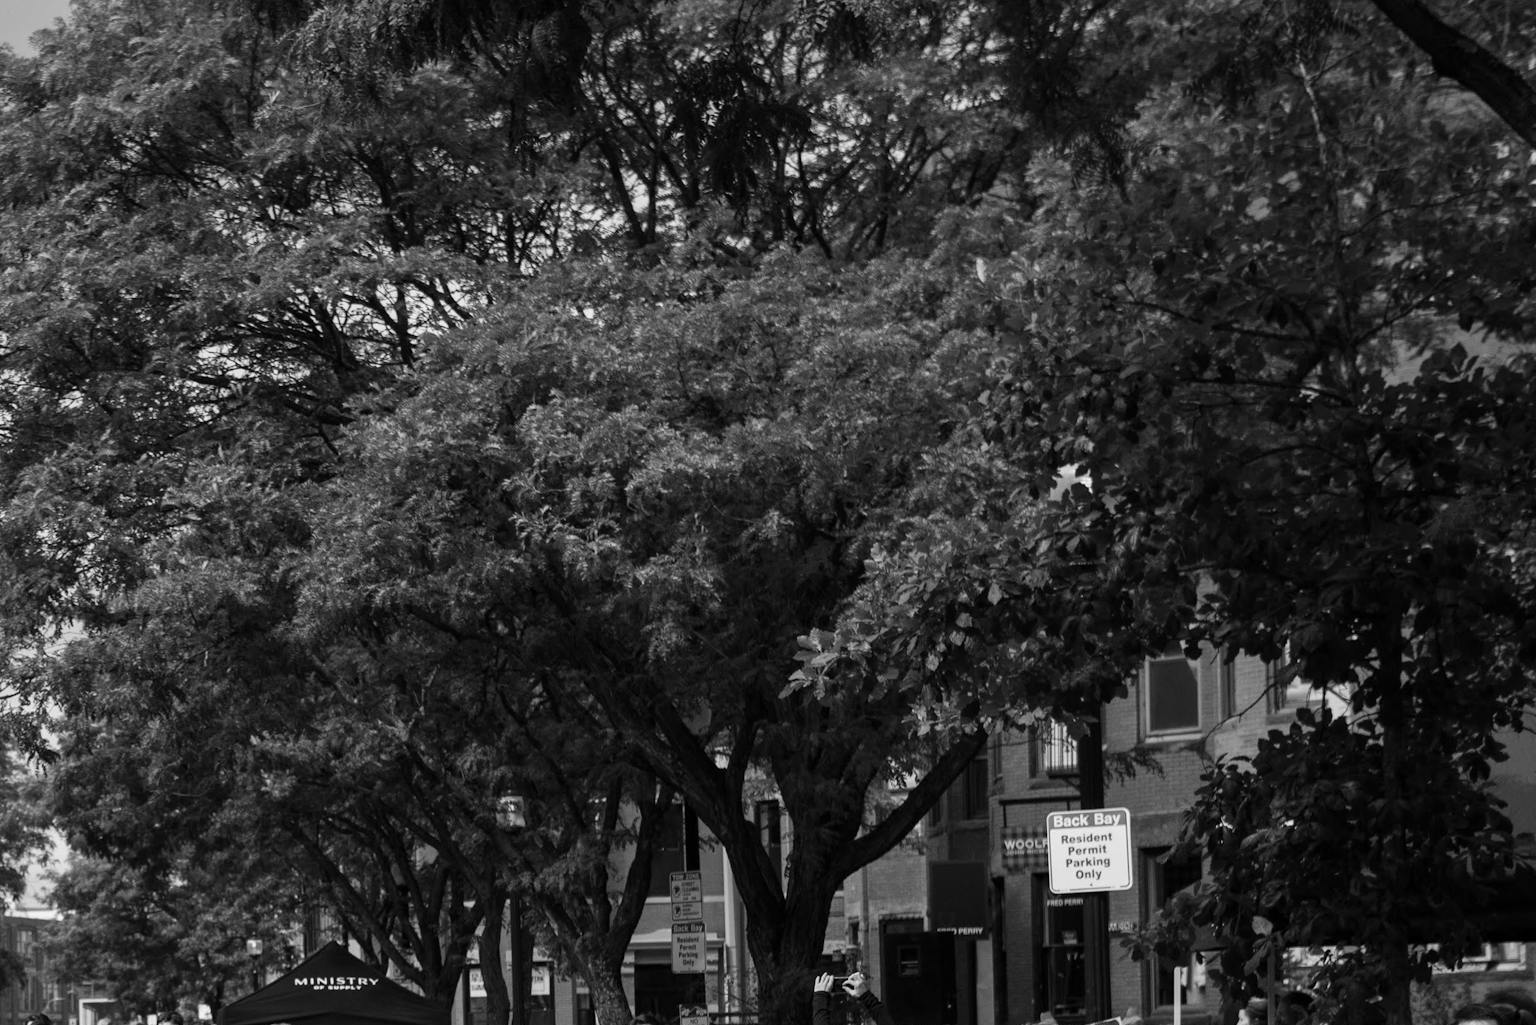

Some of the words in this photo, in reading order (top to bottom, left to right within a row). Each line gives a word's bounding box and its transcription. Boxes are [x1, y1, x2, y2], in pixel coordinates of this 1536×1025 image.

[1054, 814, 1090, 827] Back
[1094, 812, 1121, 826] Bay
[1061, 833, 1112, 844] Resident
[1068, 845, 1107, 855] Permit
[1066, 858, 1111, 868] Parking
[1076, 870, 1102, 880] Only
[958, 927, 984, 935] PERRY
[294, 977, 379, 986] MINISTRY
